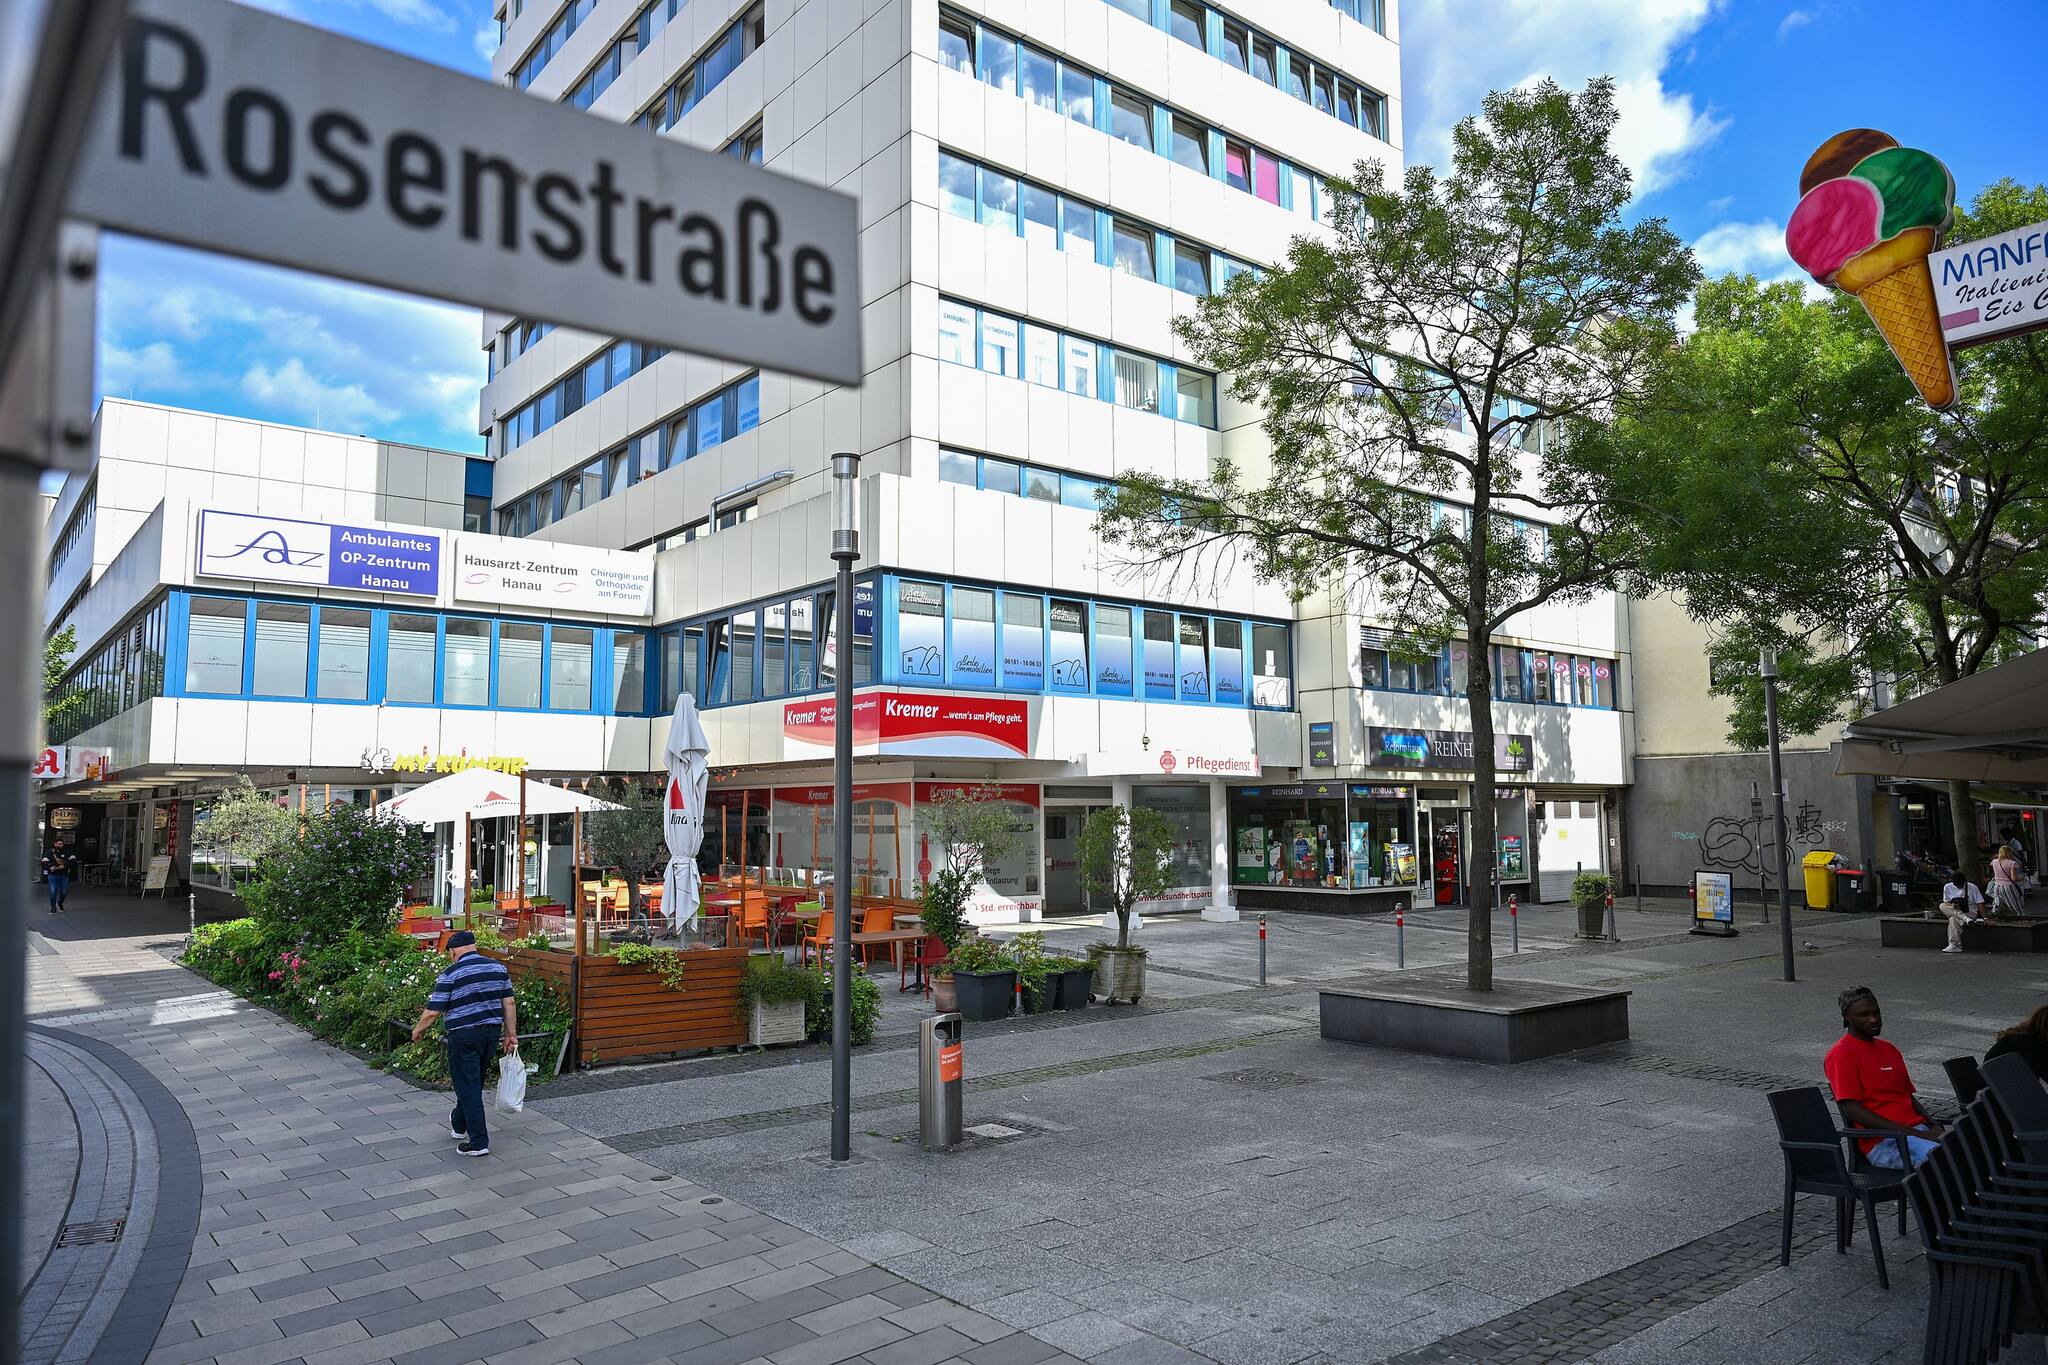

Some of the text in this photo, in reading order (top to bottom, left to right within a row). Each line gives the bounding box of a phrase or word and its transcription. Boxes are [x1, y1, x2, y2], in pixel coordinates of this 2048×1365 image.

[118, 15, 835, 327] Rosenstraße
[1943, 226, 2048, 286] MANF
[1955, 268, 2048, 304] Italieni
[1984, 298, 2025, 321] Eis
[340, 530, 432, 552] Ambulantes
[340, 551, 431, 572] OP-Zentrum
[464, 554, 578, 576] Hausarzt-Zentrum
[361, 573, 409, 590] Hanau
[590, 568, 649, 582] Chirurgie und
[502, 577, 542, 591] Hanau
[595, 579, 644, 592] Orthopädie
[612, 590, 641, 600] Forum
[786, 709, 816, 726] Kremer
[885, 699, 939, 719] Kremer
[973, 713, 984, 721] um
[985, 712, 1006, 723] Pflege
[1006, 713, 1023, 724] geht.
[1187, 756, 1251, 773] Pflegedienst
[808, 789, 829, 800] Kremer
[1272, 787, 1304, 796] REINHARD
[986, 876, 1019, 885] Entlastung
[980, 901, 1038, 912] Std. erreichbar
